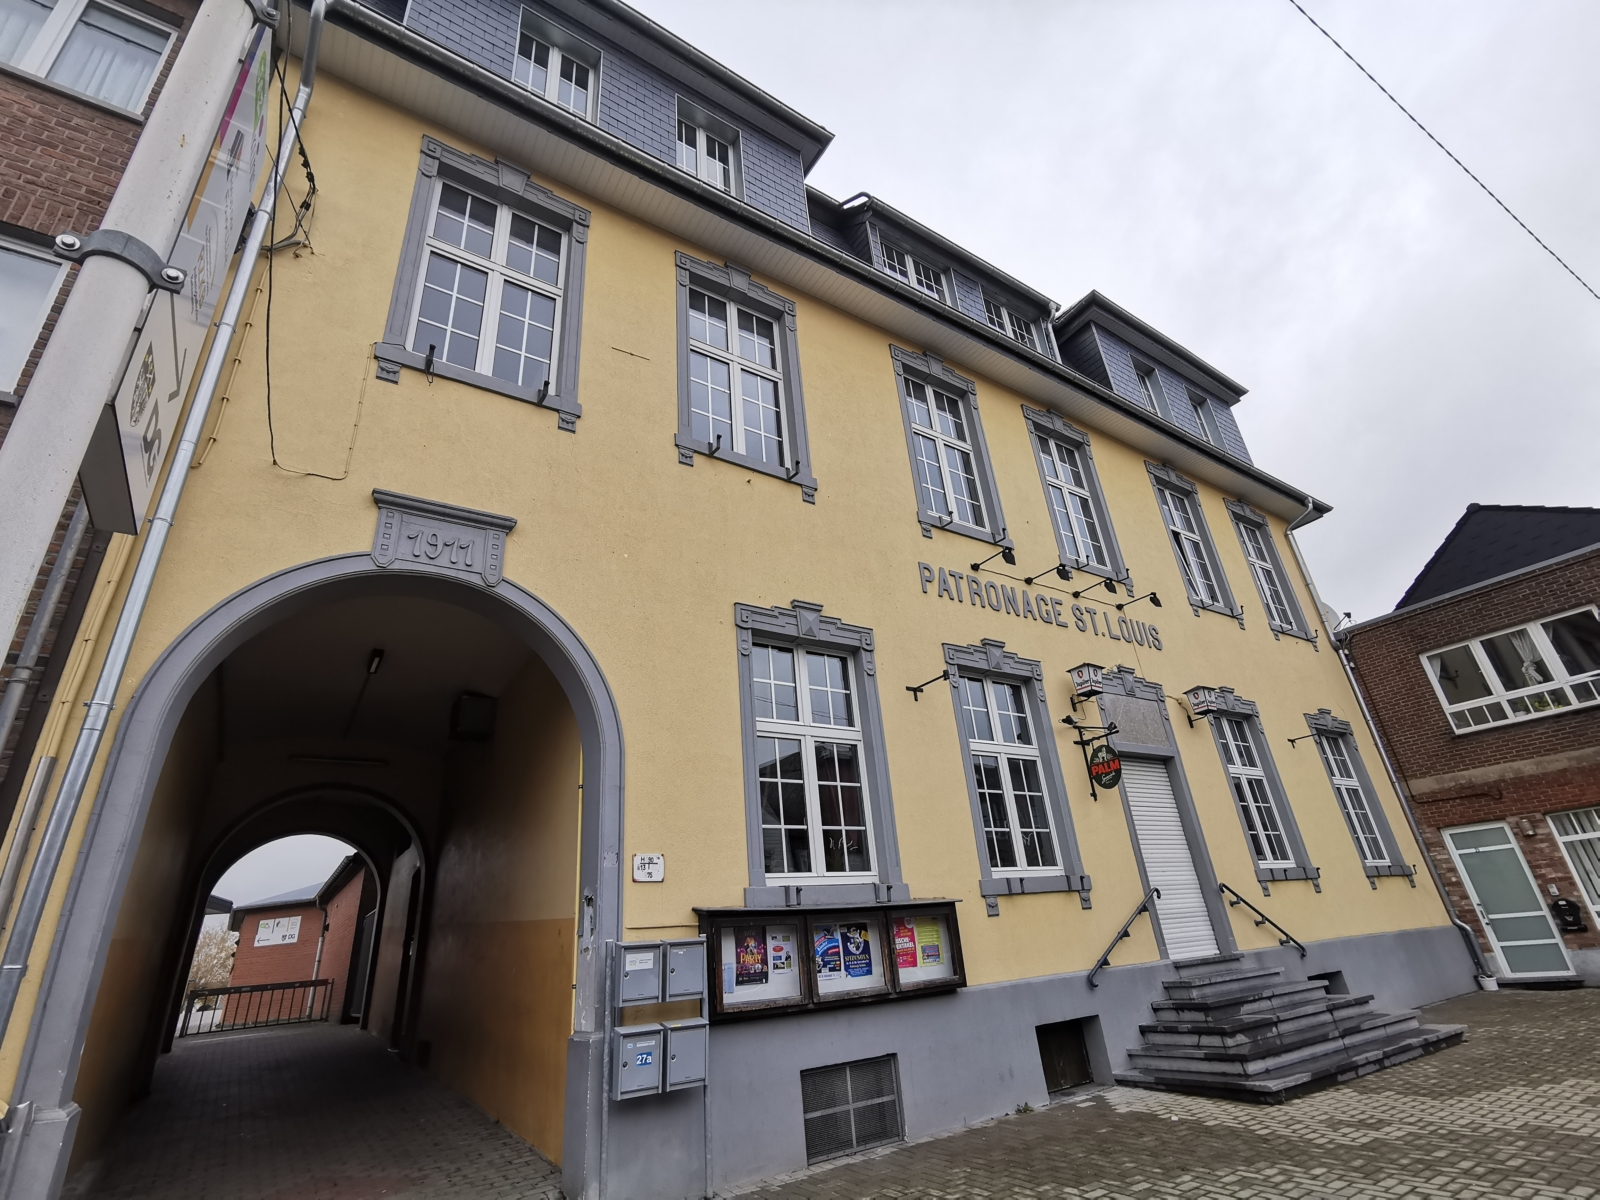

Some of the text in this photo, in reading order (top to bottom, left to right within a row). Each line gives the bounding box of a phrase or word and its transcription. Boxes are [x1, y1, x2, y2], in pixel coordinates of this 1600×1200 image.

[142, 397, 162, 483] DG
[407, 529, 475, 567] 1911
[917, 561, 1068, 628] PATRONAGE
[1091, 759, 1120, 777] PALM
[740, 952, 762, 964] PARTY
[636, 1054, 652, 1065] 27a
